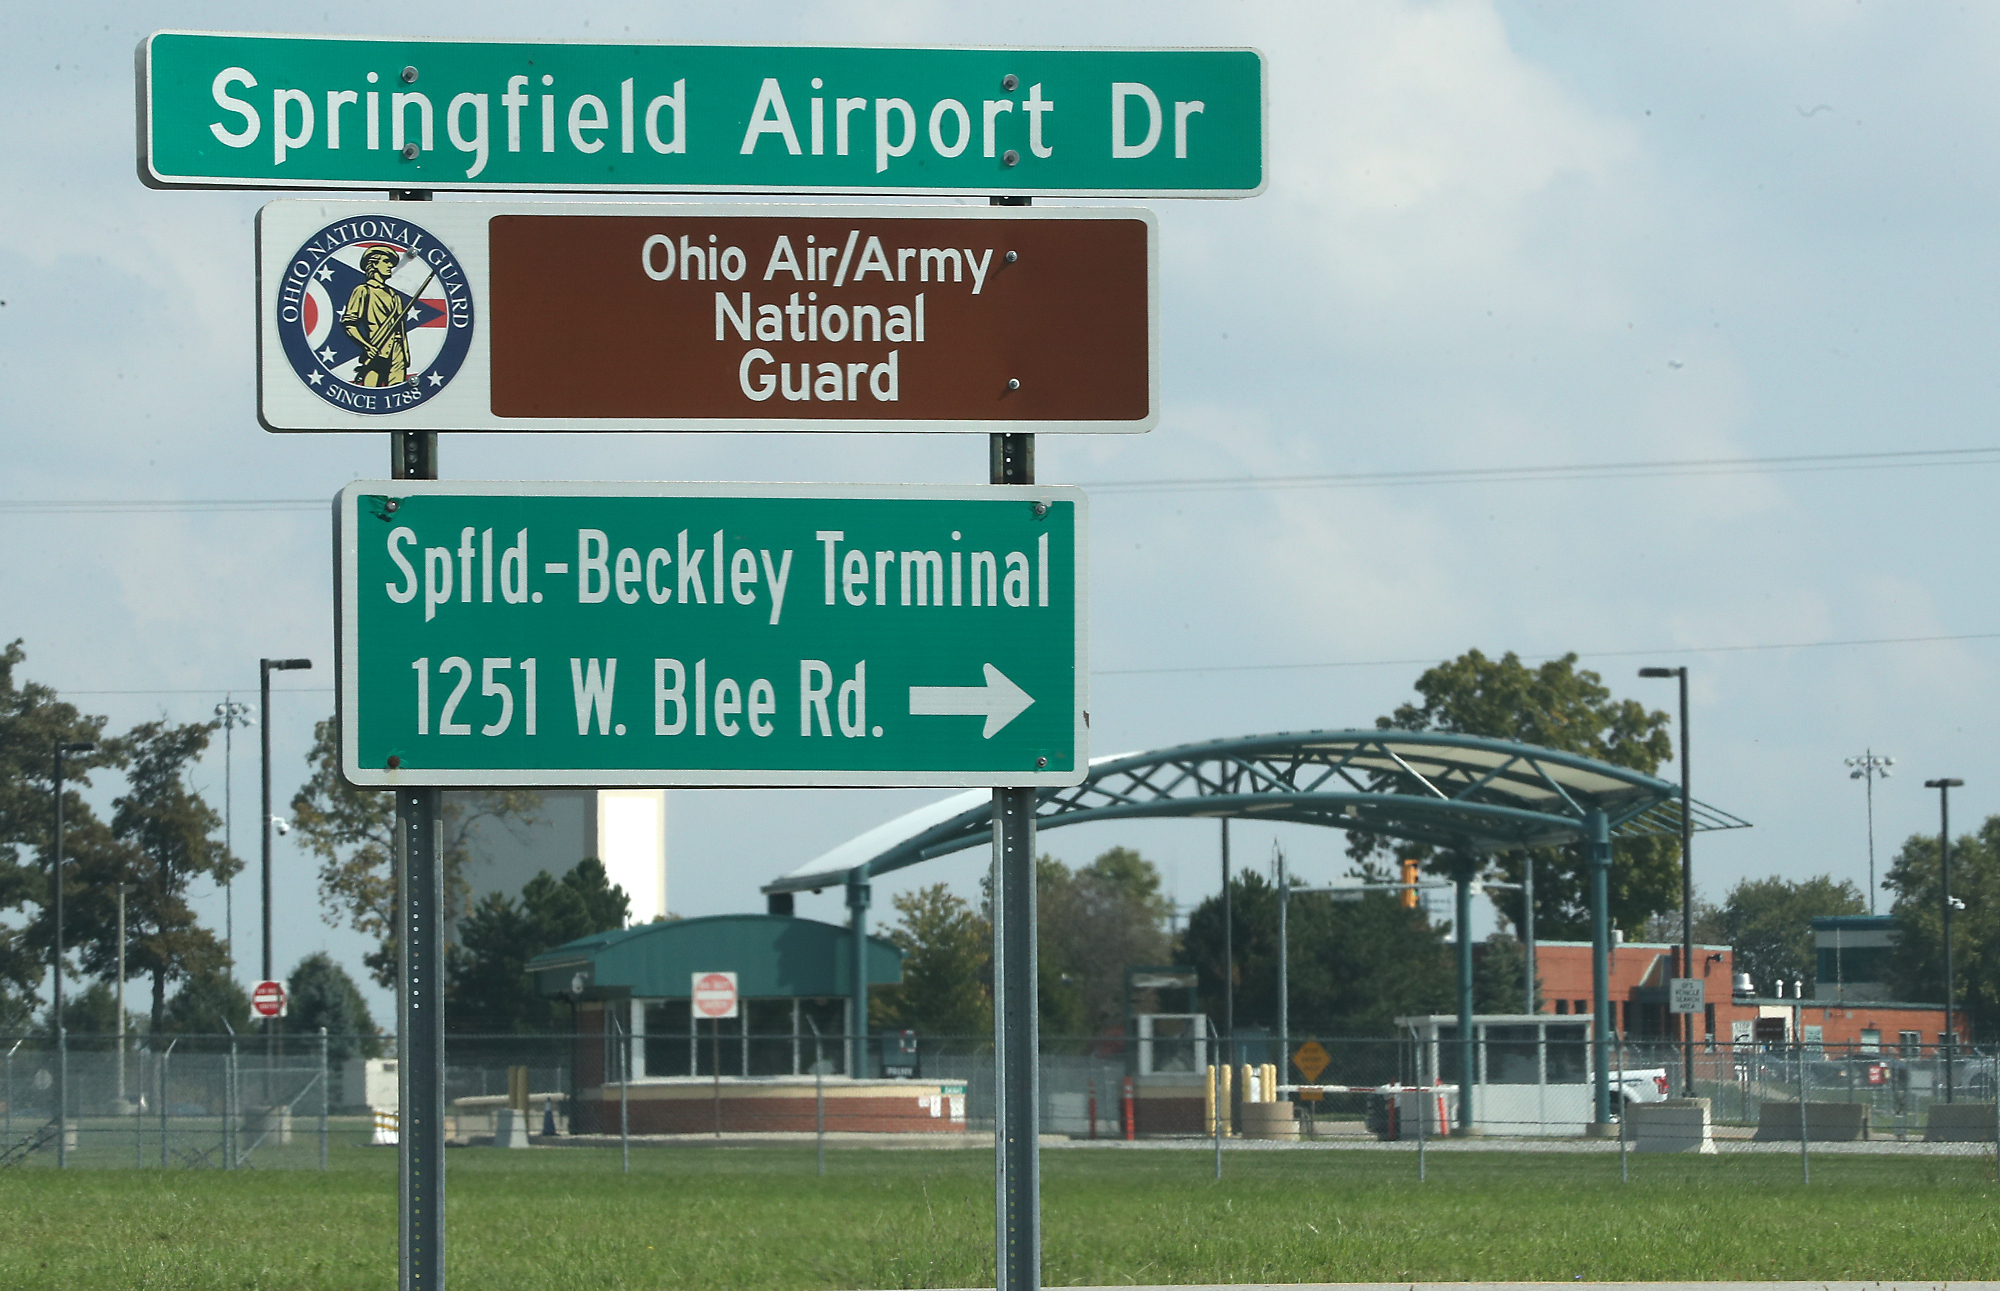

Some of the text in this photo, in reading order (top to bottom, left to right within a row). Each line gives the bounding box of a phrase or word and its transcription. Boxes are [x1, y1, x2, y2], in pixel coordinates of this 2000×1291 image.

[209, 67, 1205, 180] Springfield Airport Dr
[282, 220, 470, 329] OHIO NATIONAL GUARD
[642, 230, 993, 294] Ohio Air/Army
[715, 291, 925, 342] National
[326, 384, 422, 410] SINCE 1788
[739, 348, 899, 401] Guard
[385, 526, 1049, 625] Spfld.-Beckley Terminal
[412, 656, 884, 738] 1251 W. Blee Rd.
